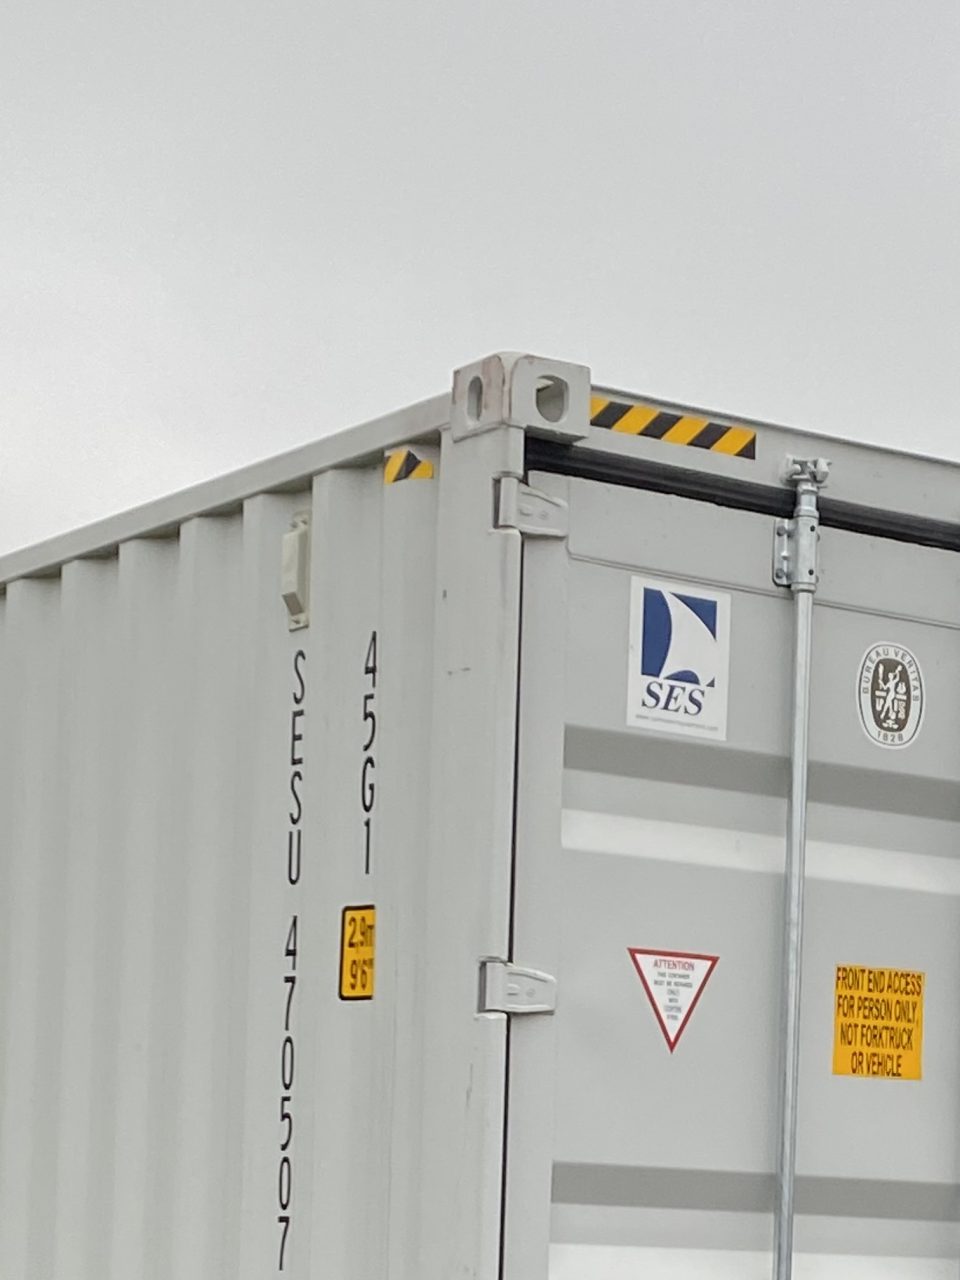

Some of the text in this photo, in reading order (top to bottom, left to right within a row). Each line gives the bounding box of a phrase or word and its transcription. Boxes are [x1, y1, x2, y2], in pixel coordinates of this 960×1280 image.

[641, 680, 705, 716] SES
[288, 649, 306, 885] SESU
[361, 630, 377, 875] 45G1
[836, 967, 922, 996] FRONT END ACCESS
[837, 994, 855, 1018] FOR
[857, 996, 893, 1021] PERSON
[840, 1023, 859, 1046] NOT
[851, 1051, 902, 1077] OR VEHICLE
[277, 914, 298, 1271] 470507
